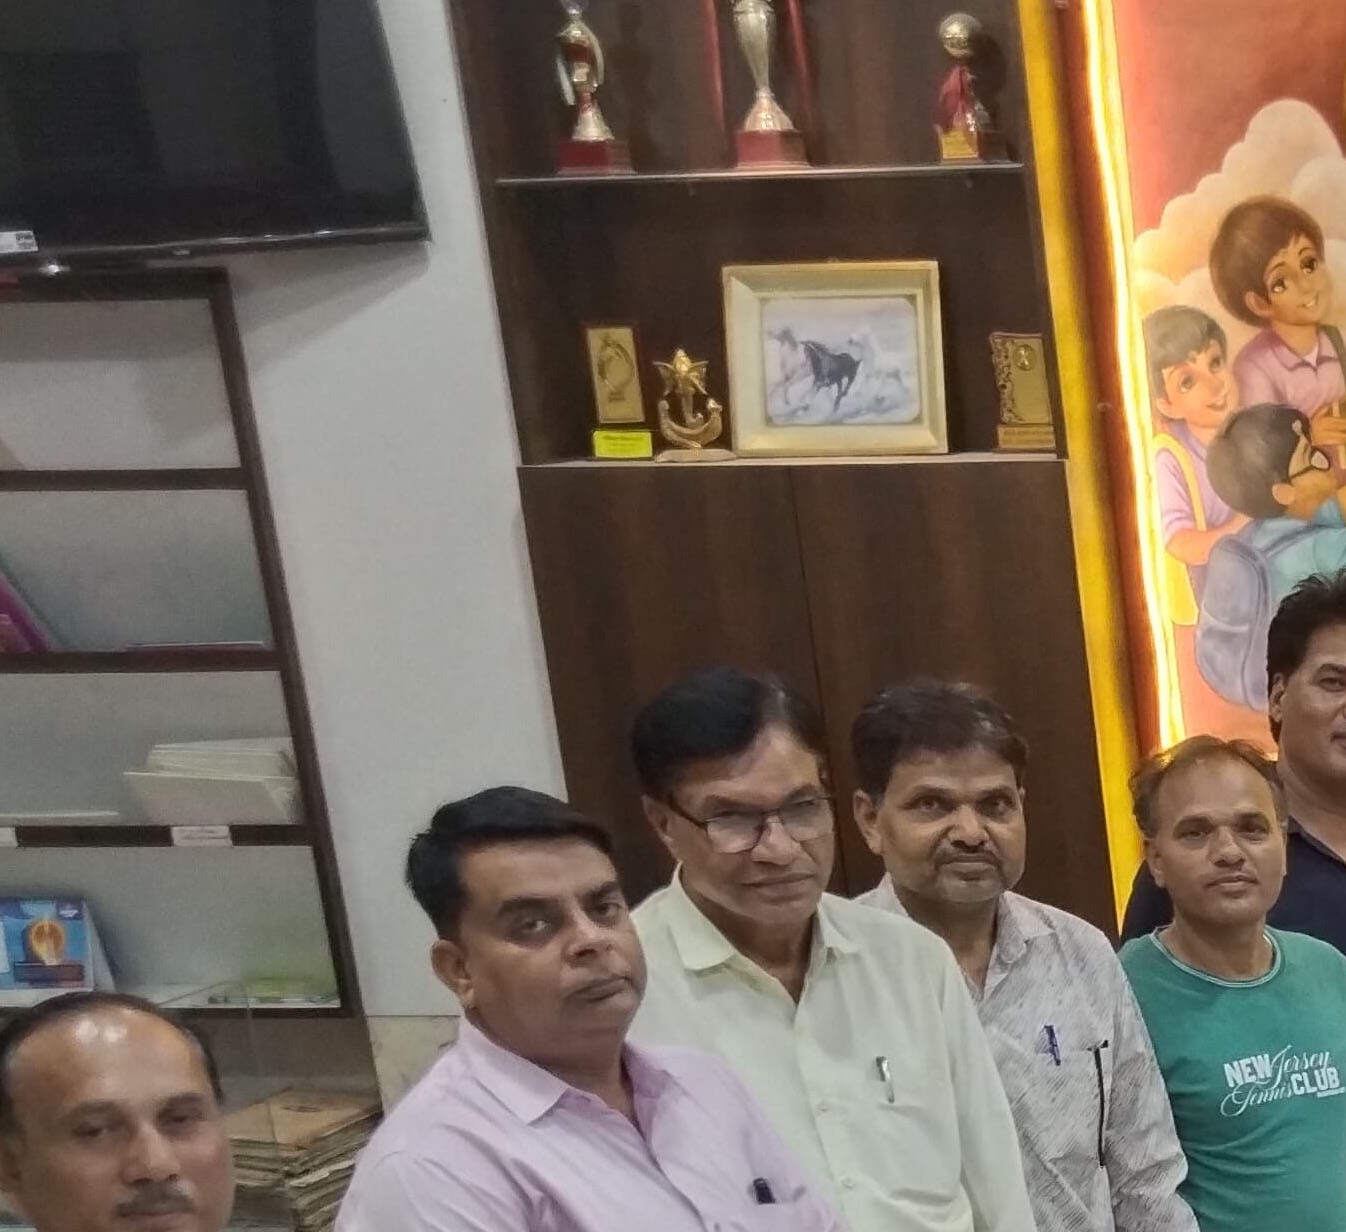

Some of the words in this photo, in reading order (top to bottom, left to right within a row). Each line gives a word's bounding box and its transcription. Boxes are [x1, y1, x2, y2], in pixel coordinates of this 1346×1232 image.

[1224, 1054, 1273, 1088] NEW
[1268, 1044, 1331, 1090] Jersey
[1220, 1079, 1292, 1117] Tennis
[1290, 1067, 1341, 1096] CLUB
